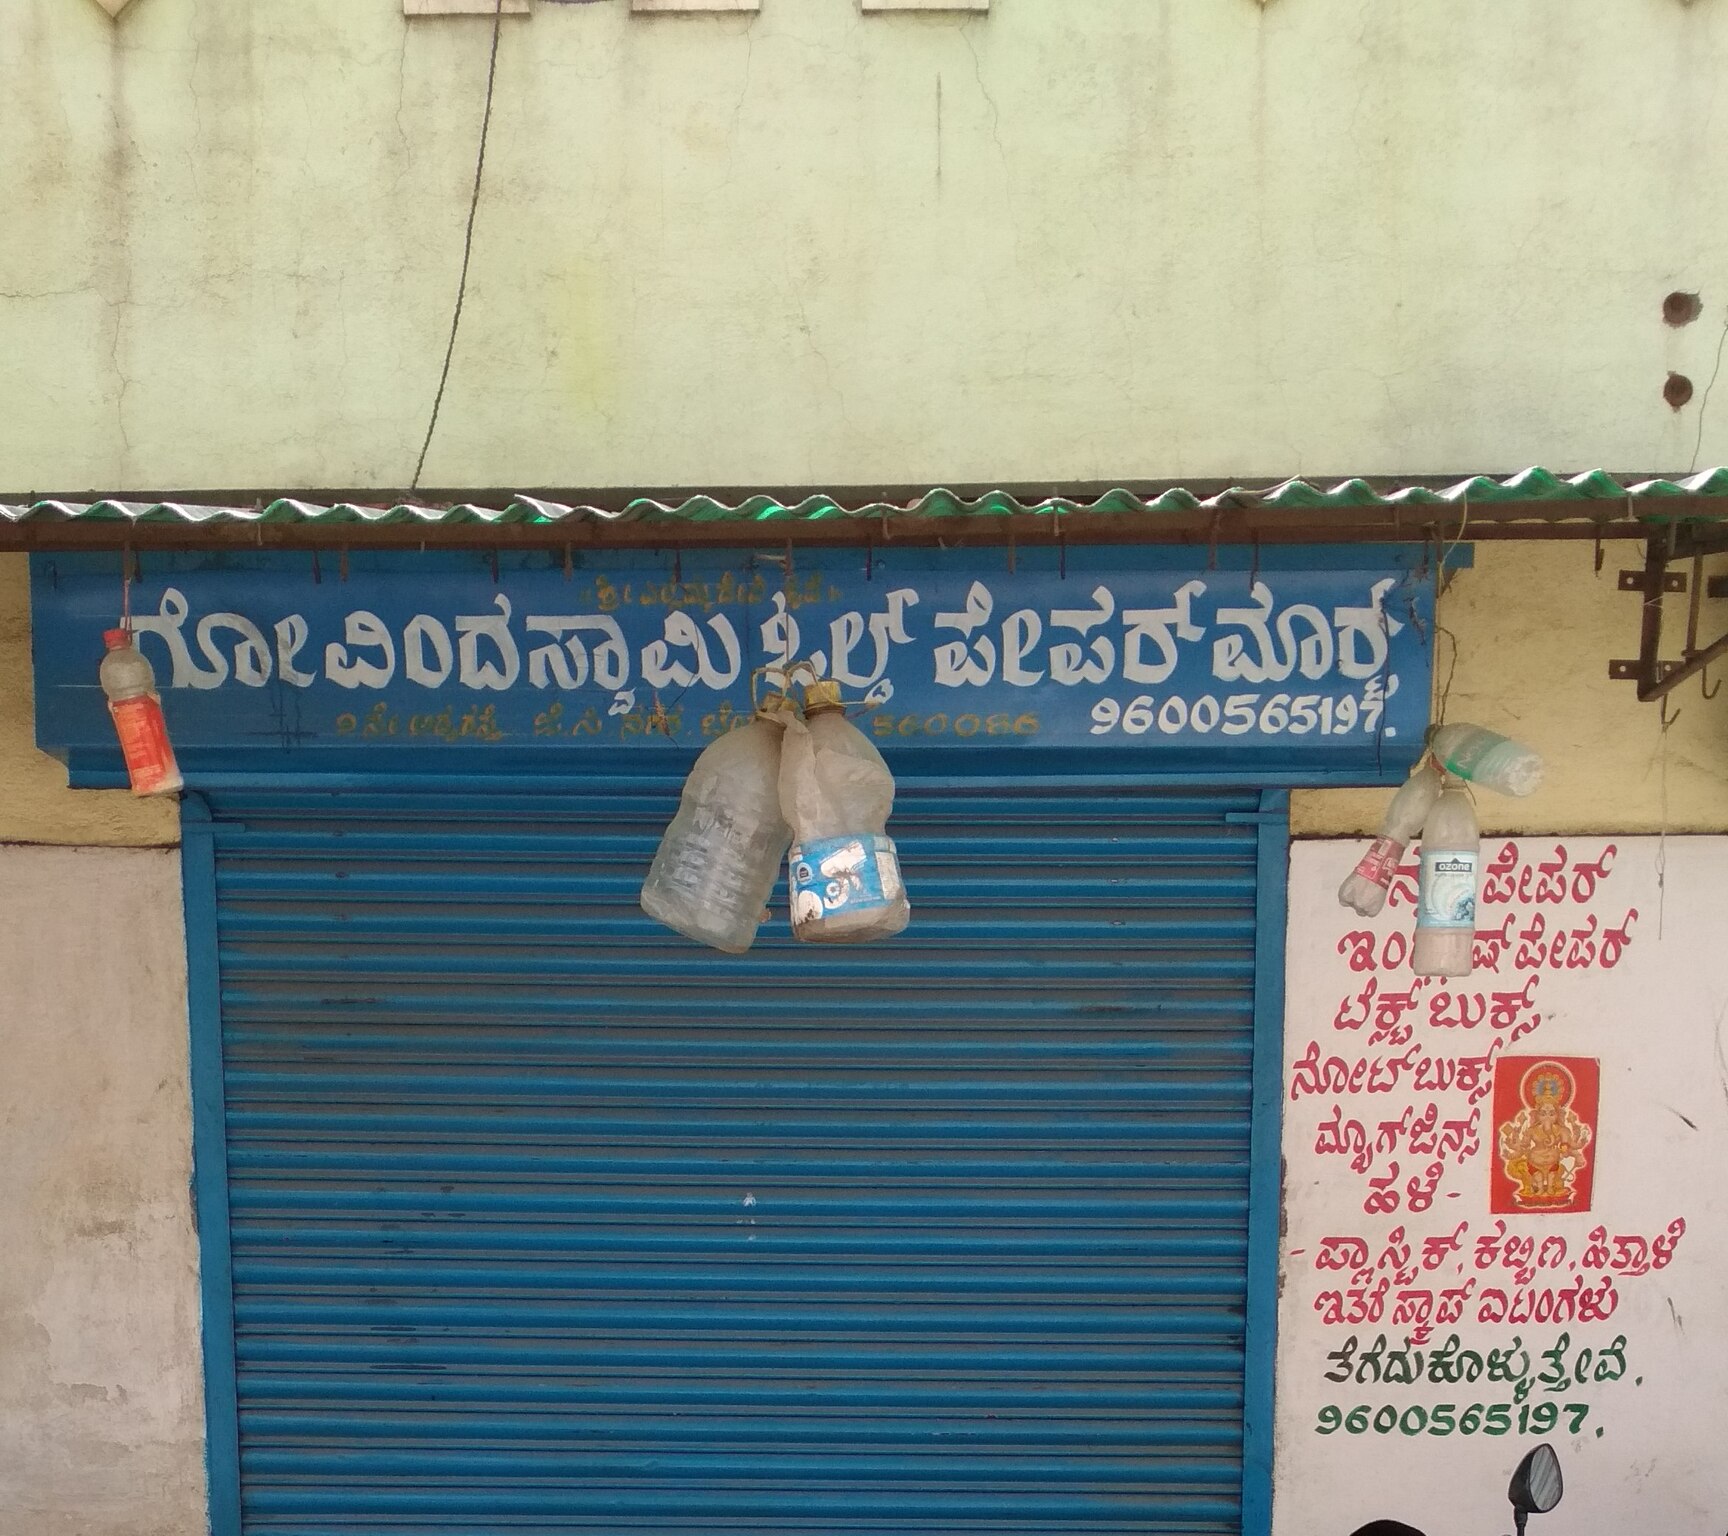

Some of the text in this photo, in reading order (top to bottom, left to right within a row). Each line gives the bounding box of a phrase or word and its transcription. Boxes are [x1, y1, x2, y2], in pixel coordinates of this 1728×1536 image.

[933, 580, 1206, 689] ಪೇಪರ್
[1482, 841, 1617, 905] ಪೇಪರ್
[1314, 1401, 1605, 1440] 9600565197.
